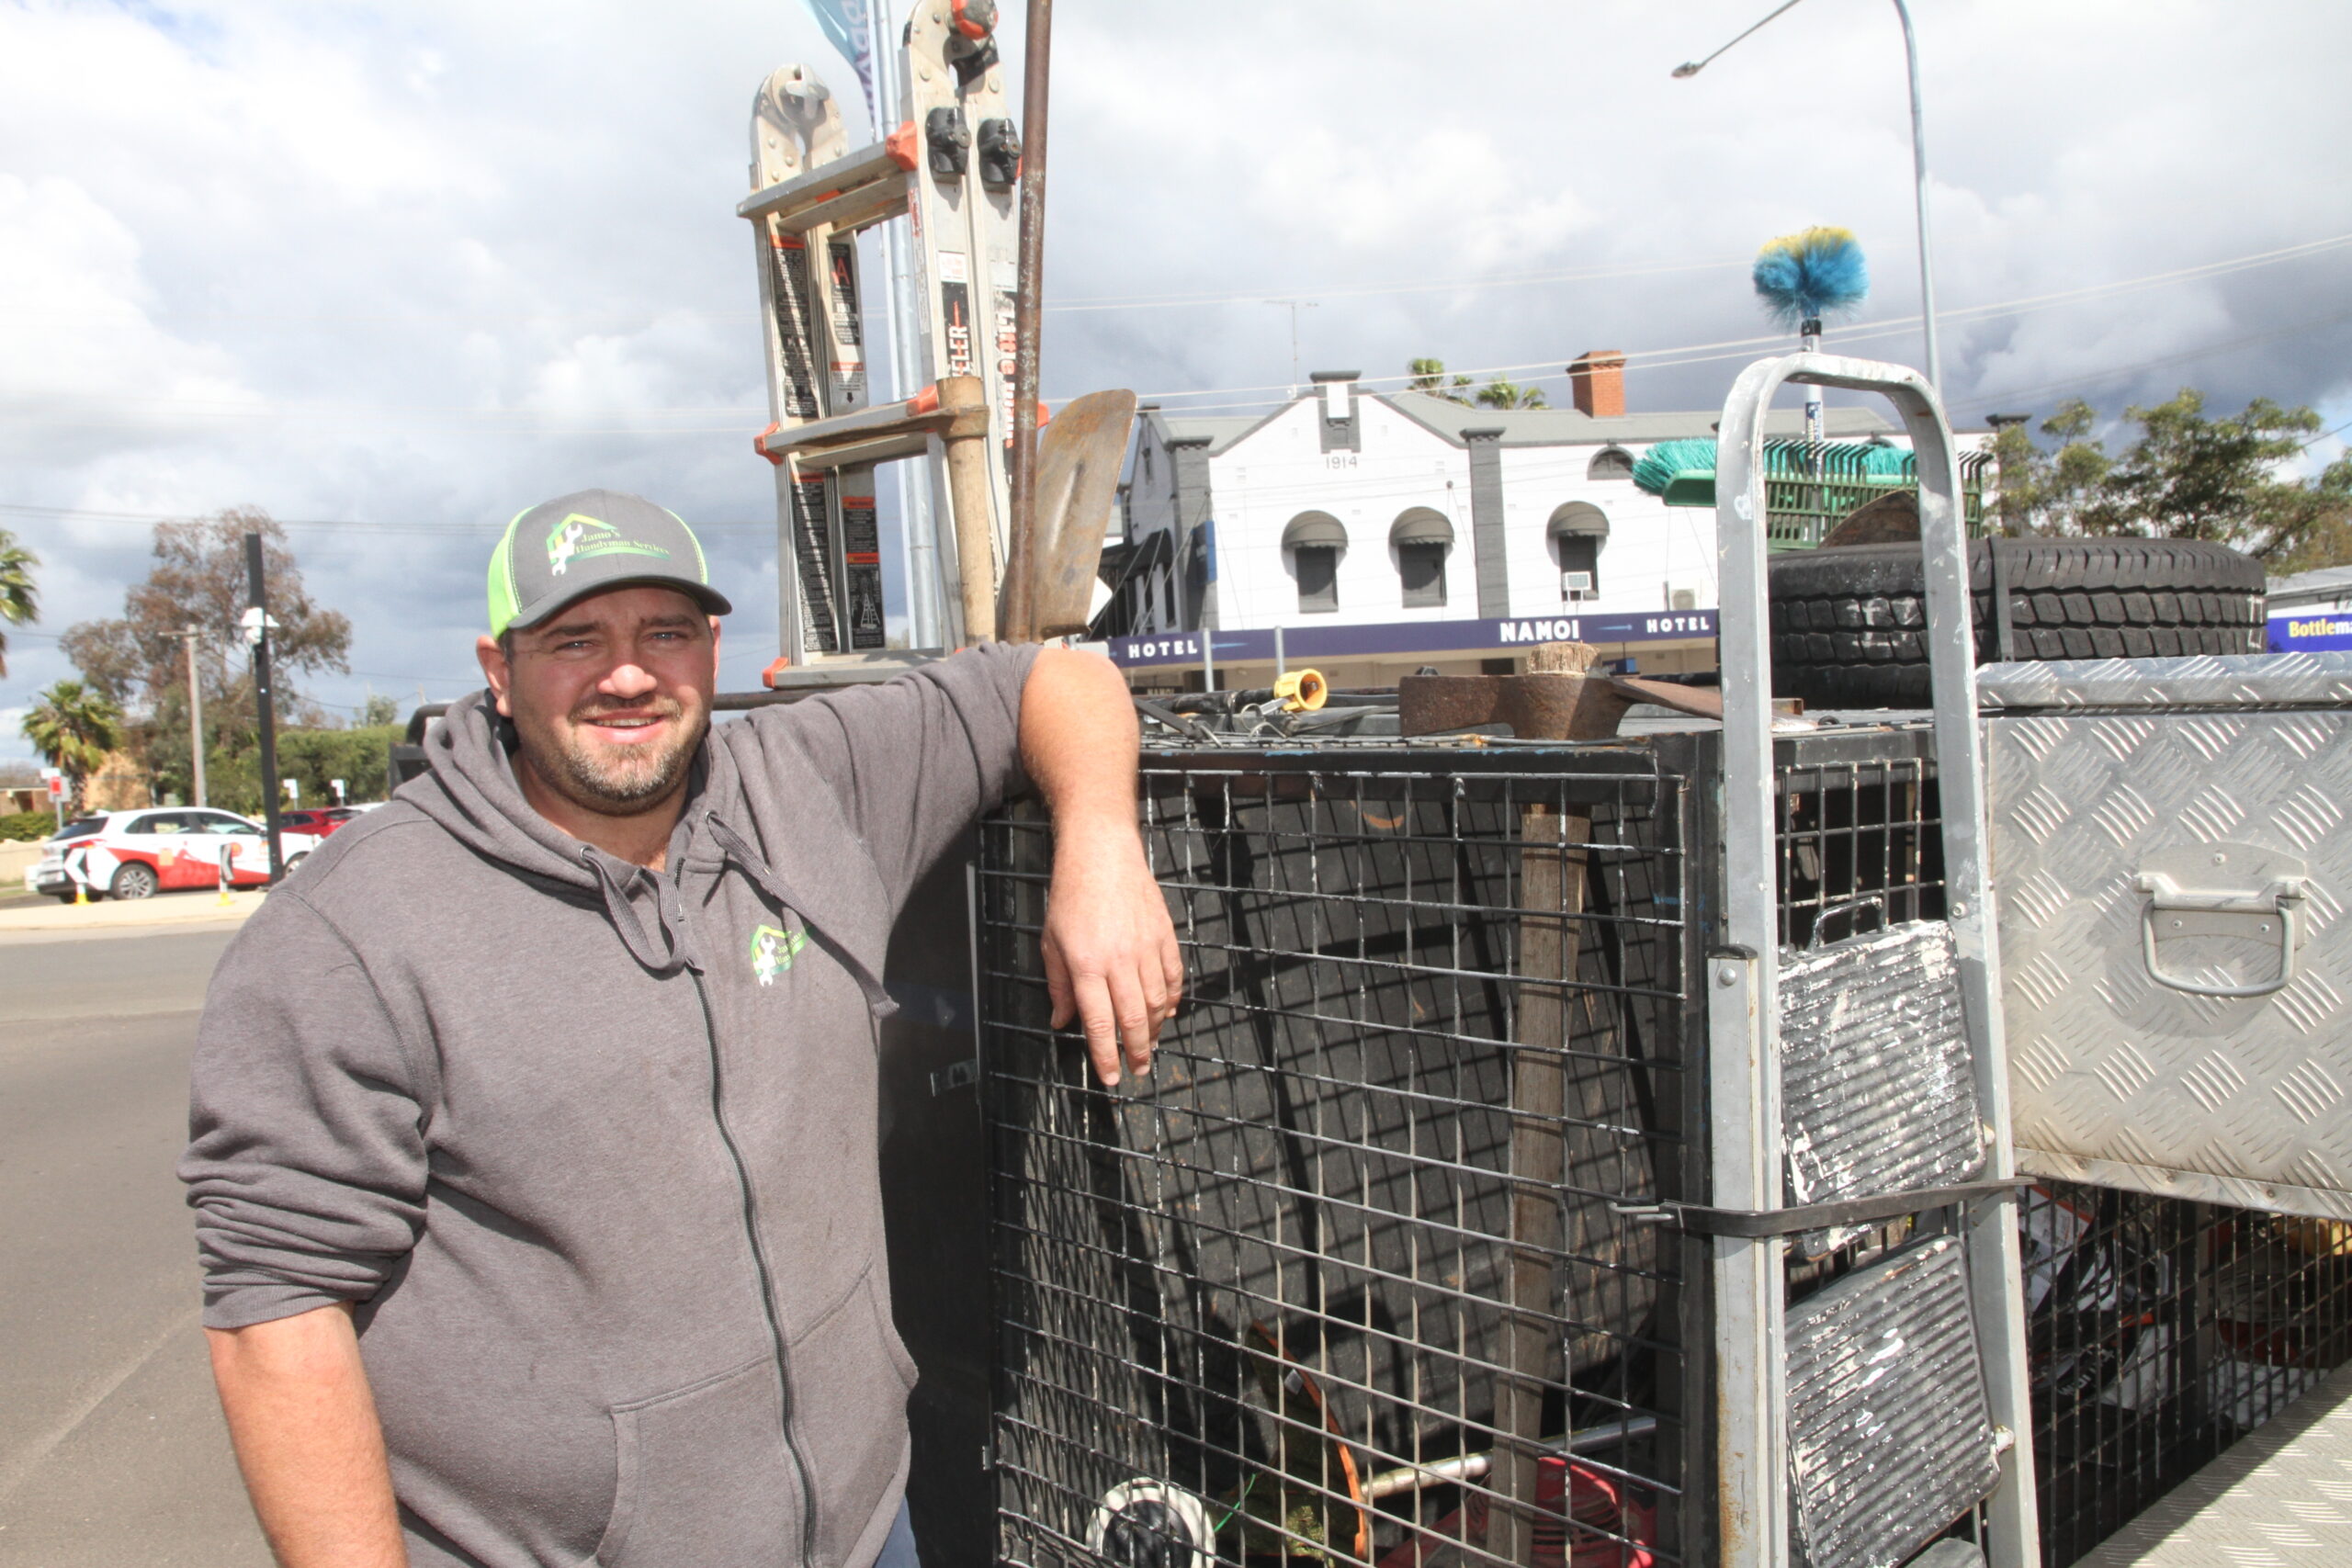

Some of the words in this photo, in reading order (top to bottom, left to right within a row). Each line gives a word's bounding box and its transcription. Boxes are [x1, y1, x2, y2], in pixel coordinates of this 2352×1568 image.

[1326, 456, 1357, 469] 1914
[575, 539, 631, 554] Handyman
[632, 539, 670, 555] Services
[1499, 619, 1580, 642] NAMOI
[1646, 616, 1710, 634] HOTEL
[1128, 639, 1198, 659] HOTEL
